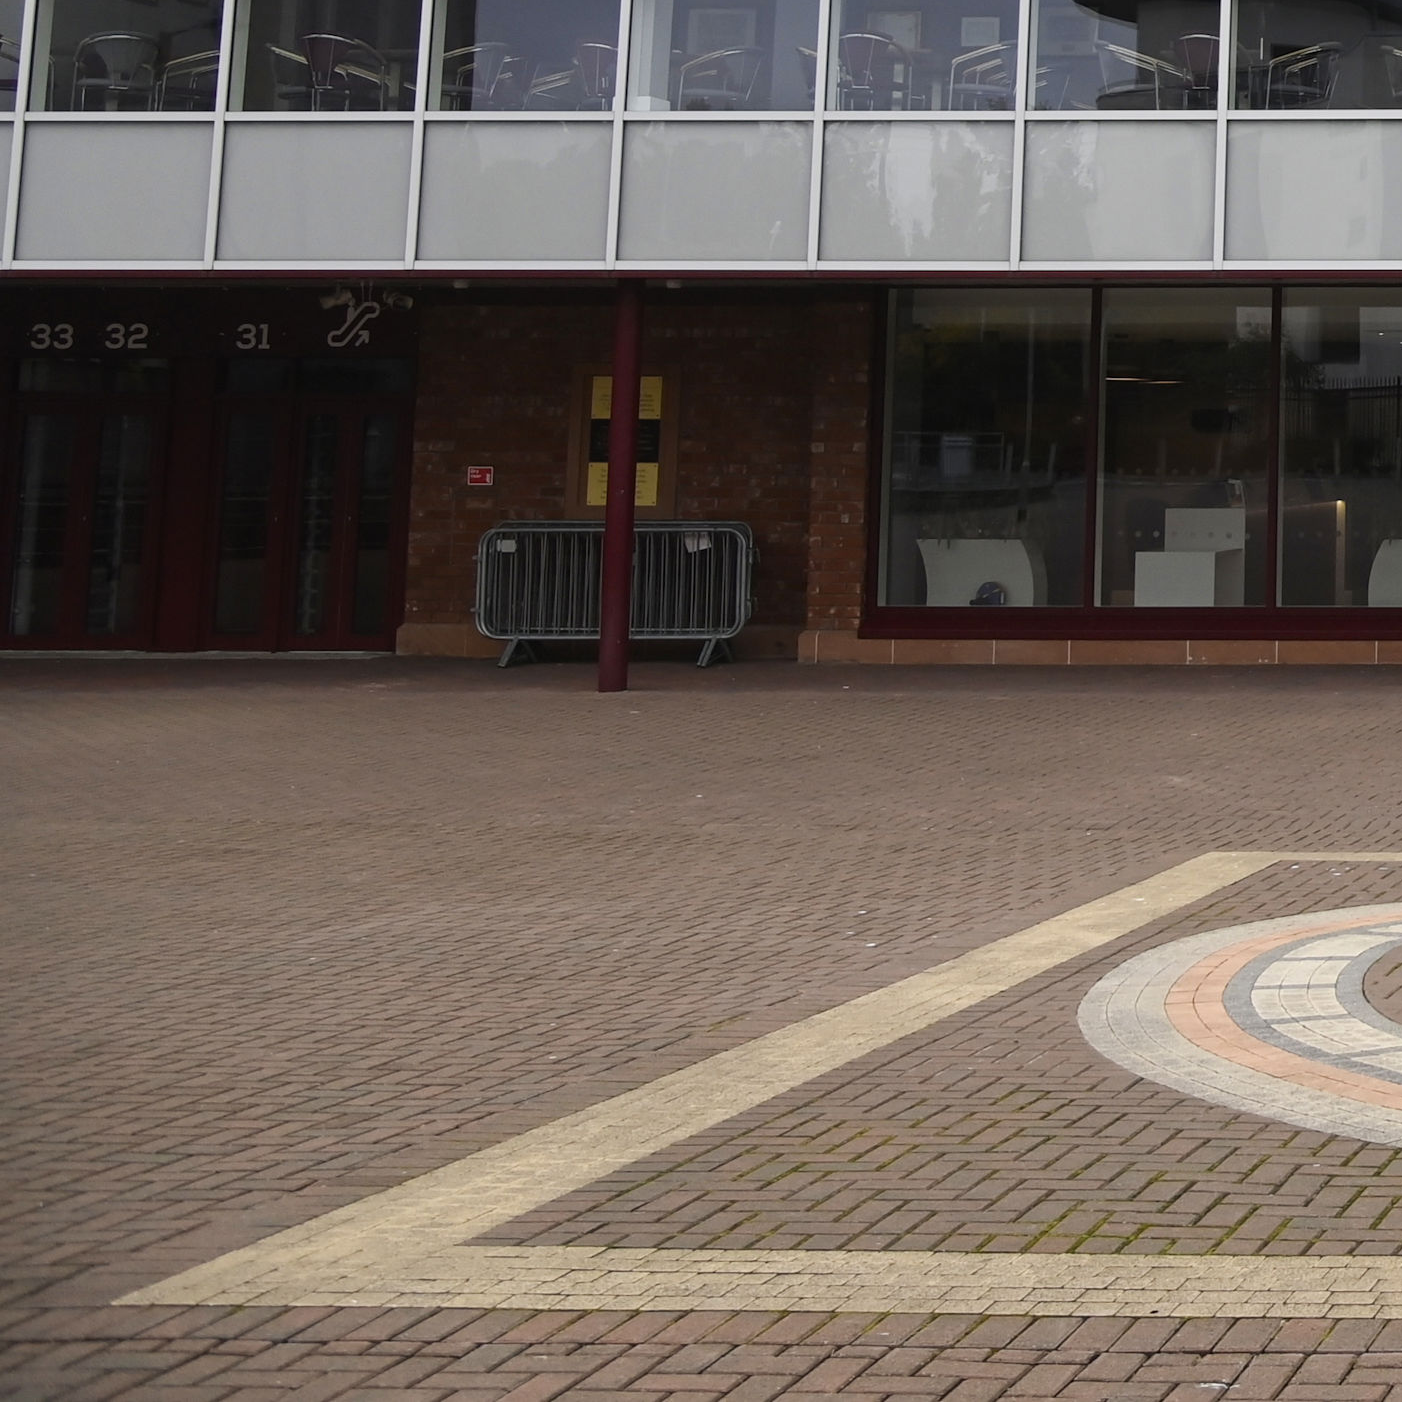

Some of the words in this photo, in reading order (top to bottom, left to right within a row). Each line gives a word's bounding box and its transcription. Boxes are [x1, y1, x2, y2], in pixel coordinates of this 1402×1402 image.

[30, 323, 74, 350] 33
[104, 323, 149, 350] 32
[236, 323, 270, 350] 31
